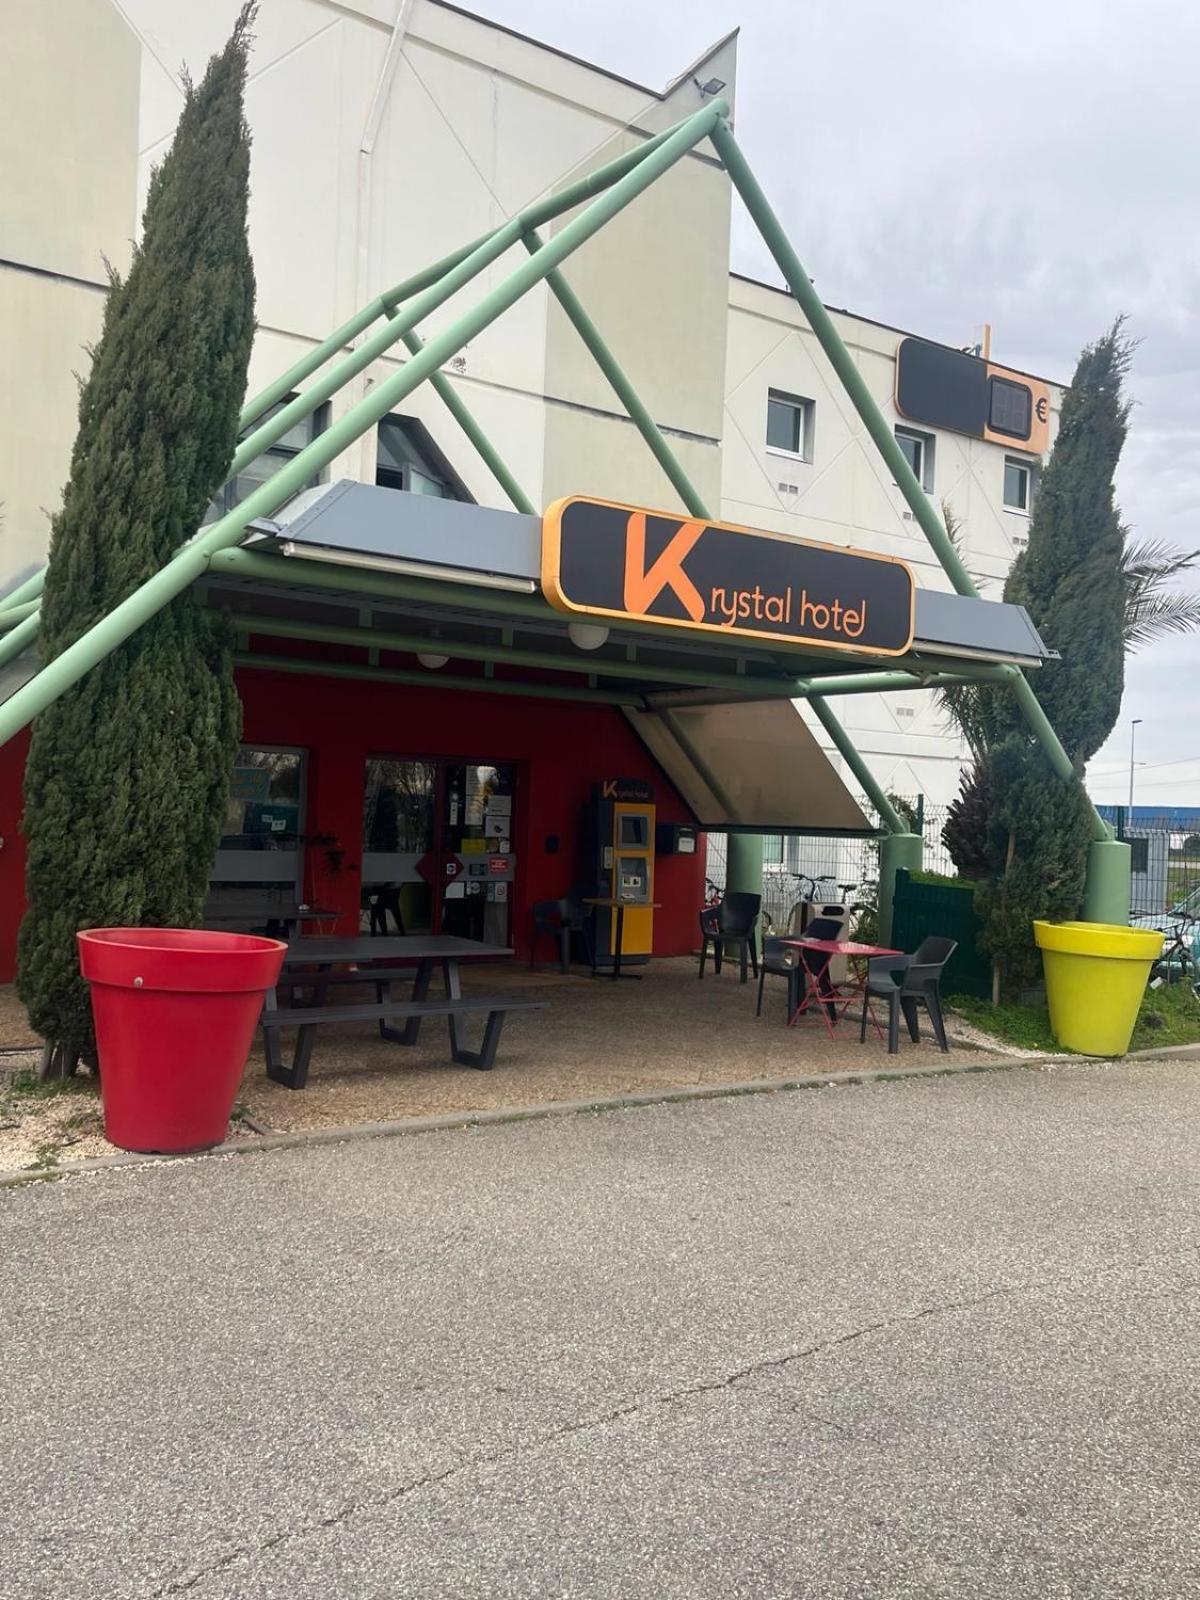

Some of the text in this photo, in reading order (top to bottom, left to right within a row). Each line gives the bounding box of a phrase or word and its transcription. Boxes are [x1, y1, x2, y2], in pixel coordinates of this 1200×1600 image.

[1036, 398, 1047, 424] €
[624, 512, 866, 637] Krystal hotel
